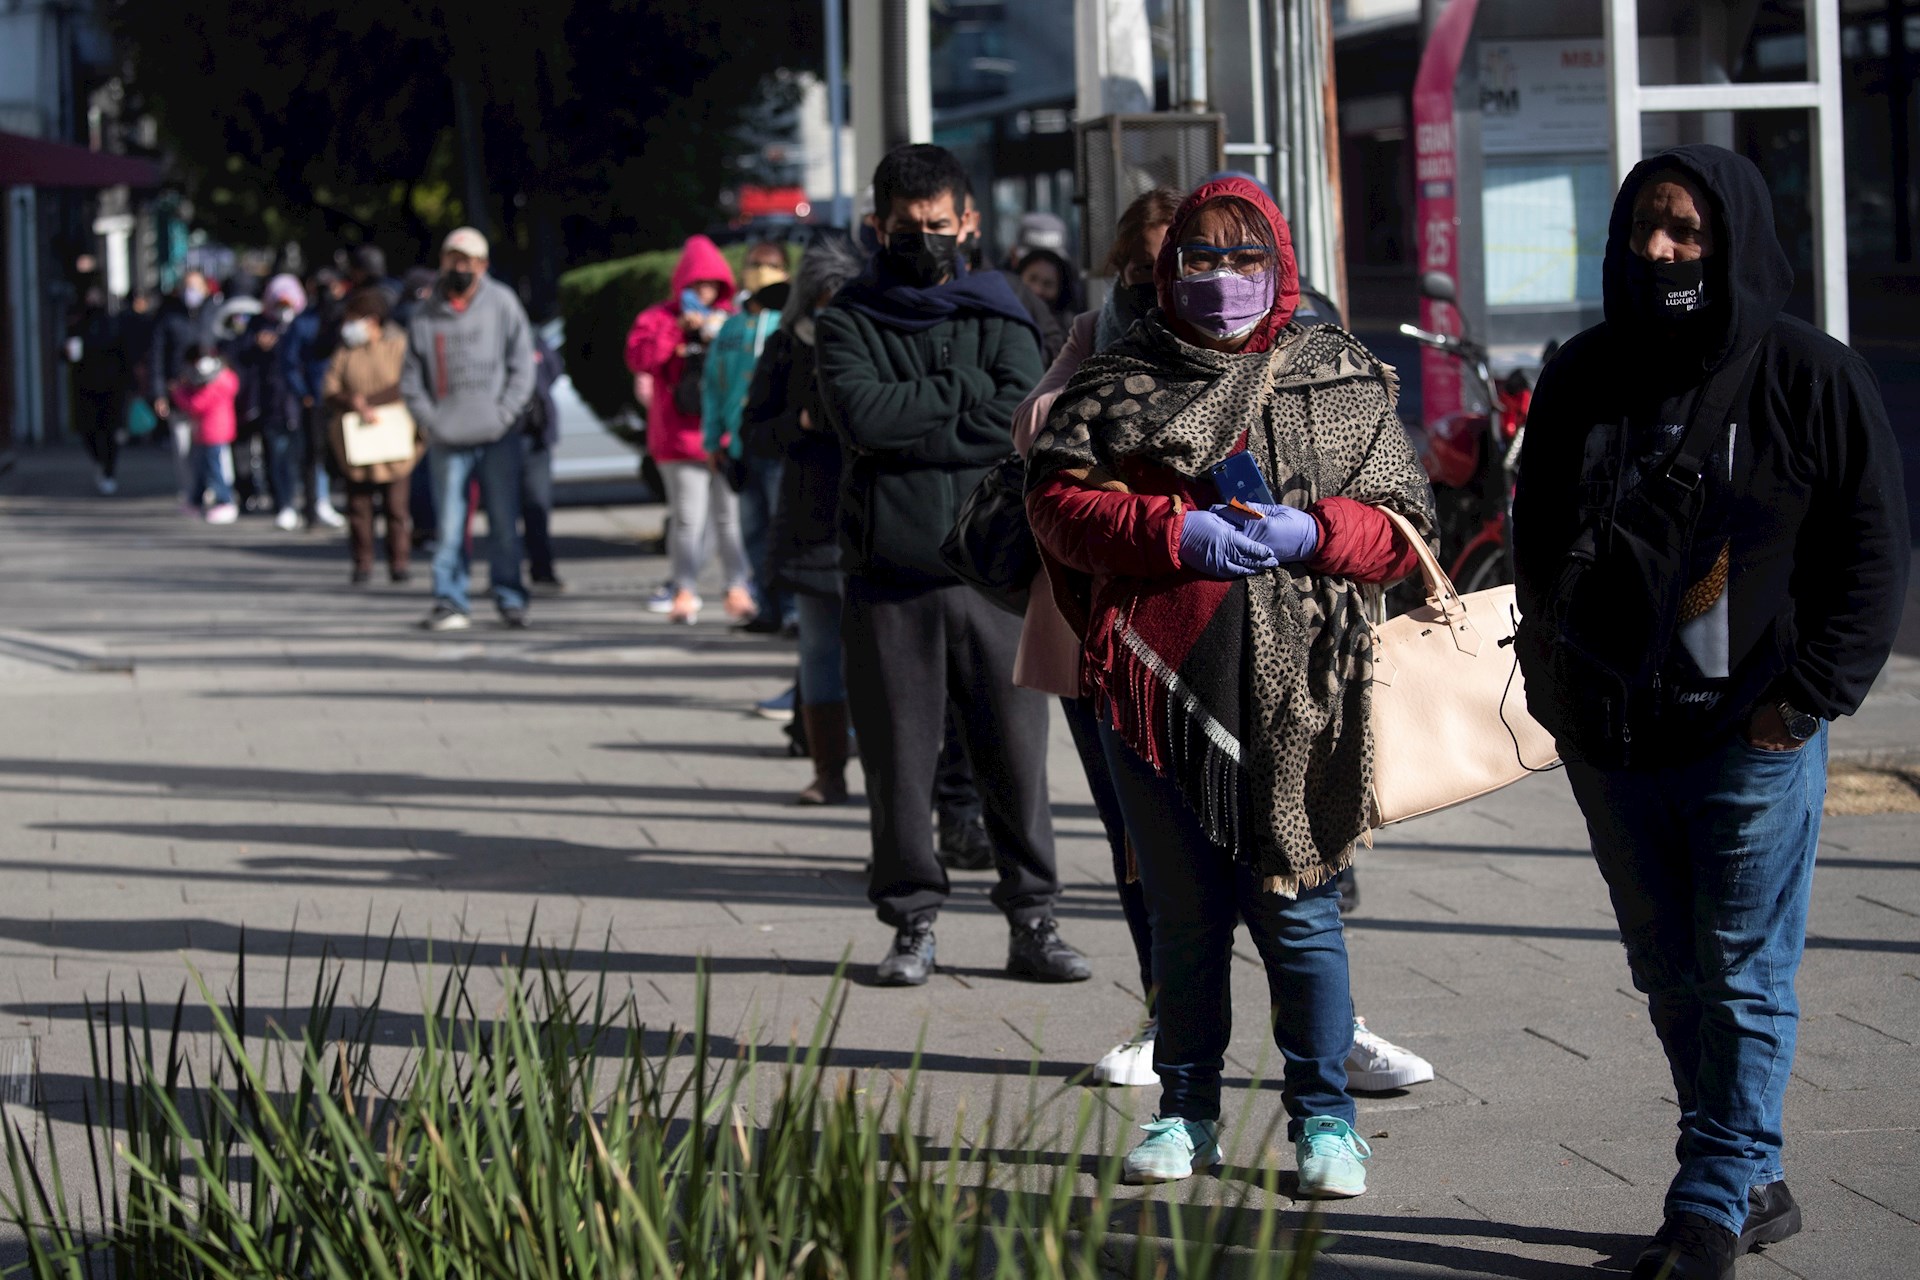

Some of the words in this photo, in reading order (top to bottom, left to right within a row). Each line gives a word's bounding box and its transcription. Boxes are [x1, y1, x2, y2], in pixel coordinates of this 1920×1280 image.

[1425, 219, 1451, 267] 25
[1667, 289, 1696, 298] GRUPO
[1665, 296, 1698, 306] LUXURY
